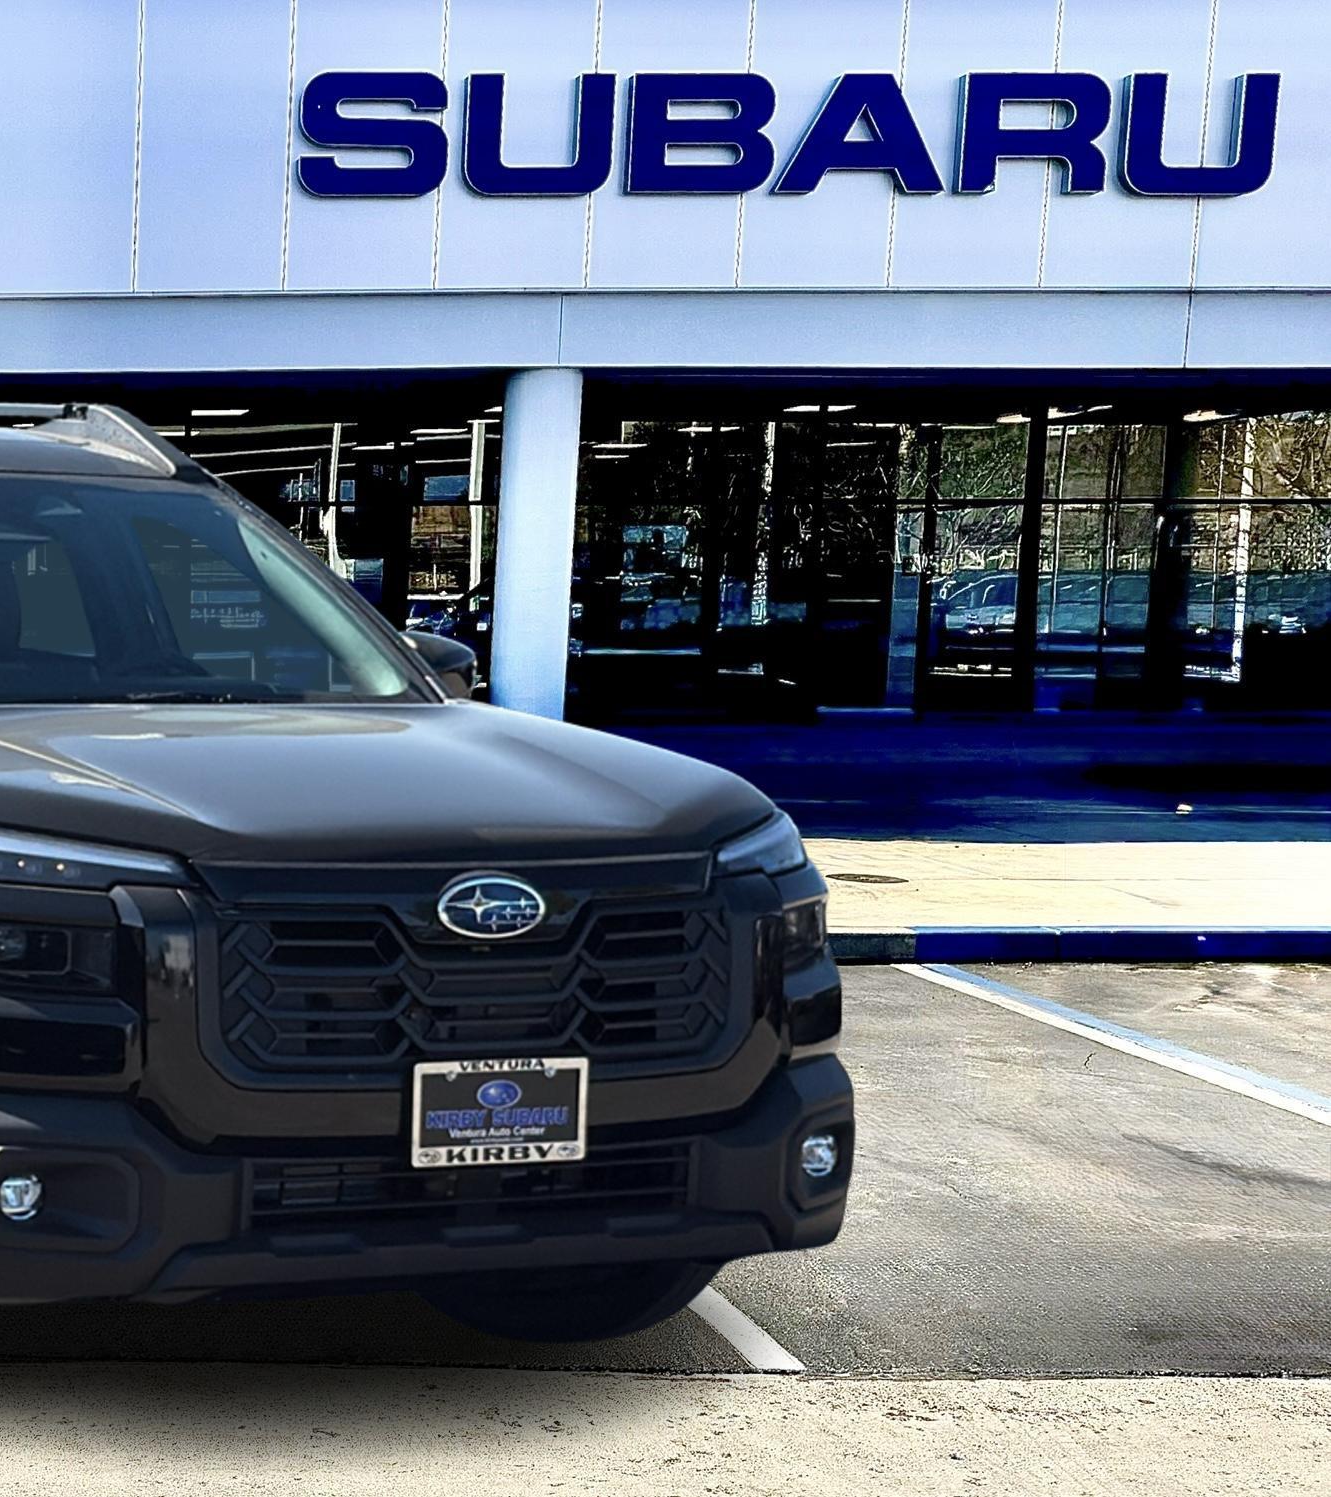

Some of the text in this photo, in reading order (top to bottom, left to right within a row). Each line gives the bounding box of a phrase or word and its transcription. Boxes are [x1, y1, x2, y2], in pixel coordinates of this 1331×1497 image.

[296, 71, 1280, 197] SUBARU
[459, 1059, 545, 1071] VENTURA
[426, 1106, 568, 1129] KIRBY SUBARU
[448, 1126, 545, 1138] Ventura Auto Center
[446, 1143, 554, 1163] KIRBY
